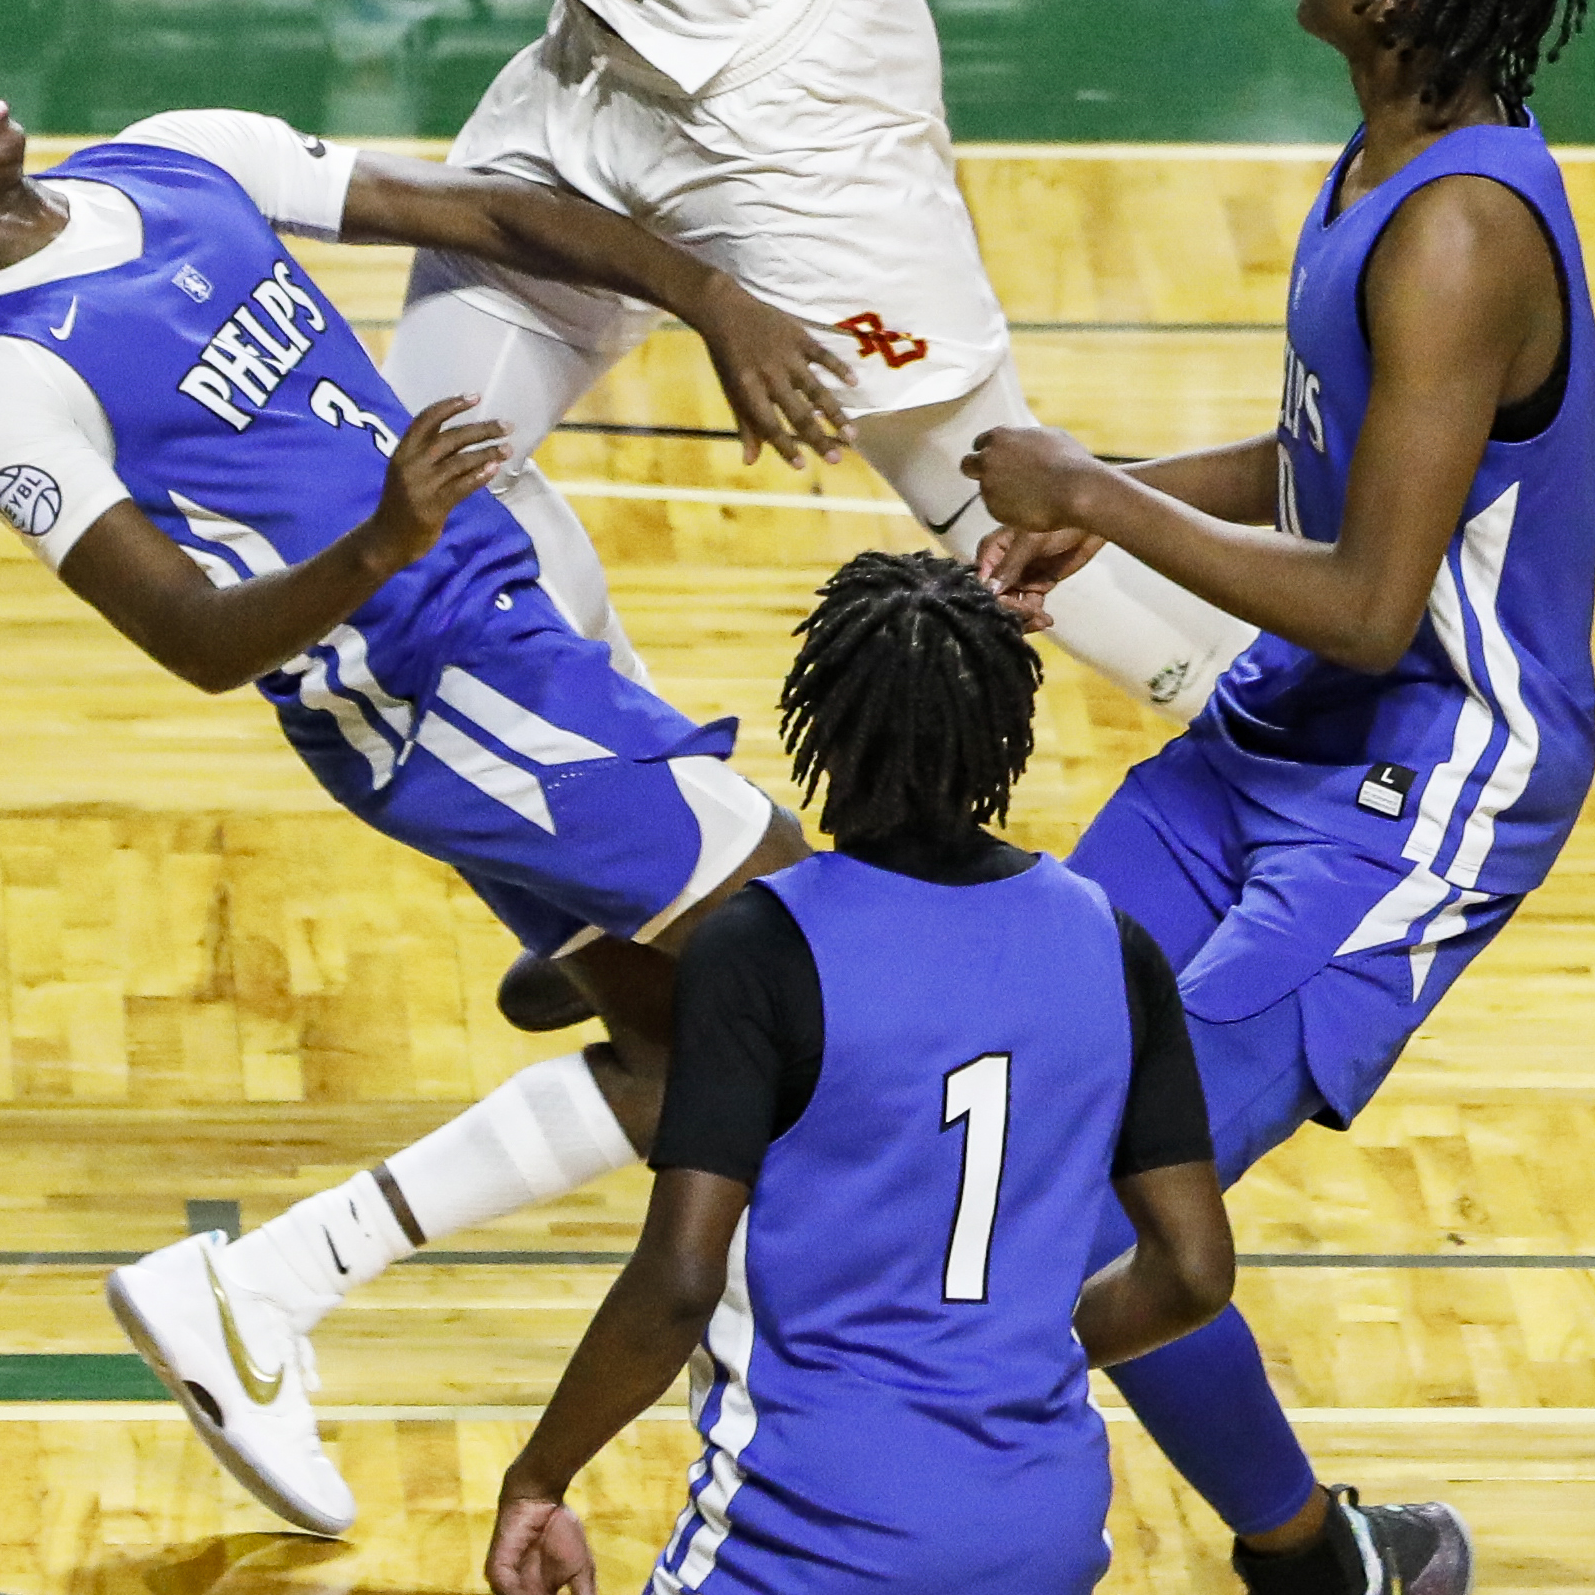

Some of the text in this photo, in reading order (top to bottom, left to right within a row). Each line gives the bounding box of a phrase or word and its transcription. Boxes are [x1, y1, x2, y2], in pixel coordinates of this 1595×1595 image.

[177, 257, 328, 435] PHELPS
[308, 377, 402, 460] 3
[1380, 766, 1395, 785] L
[939, 1050, 1012, 1305] 1
